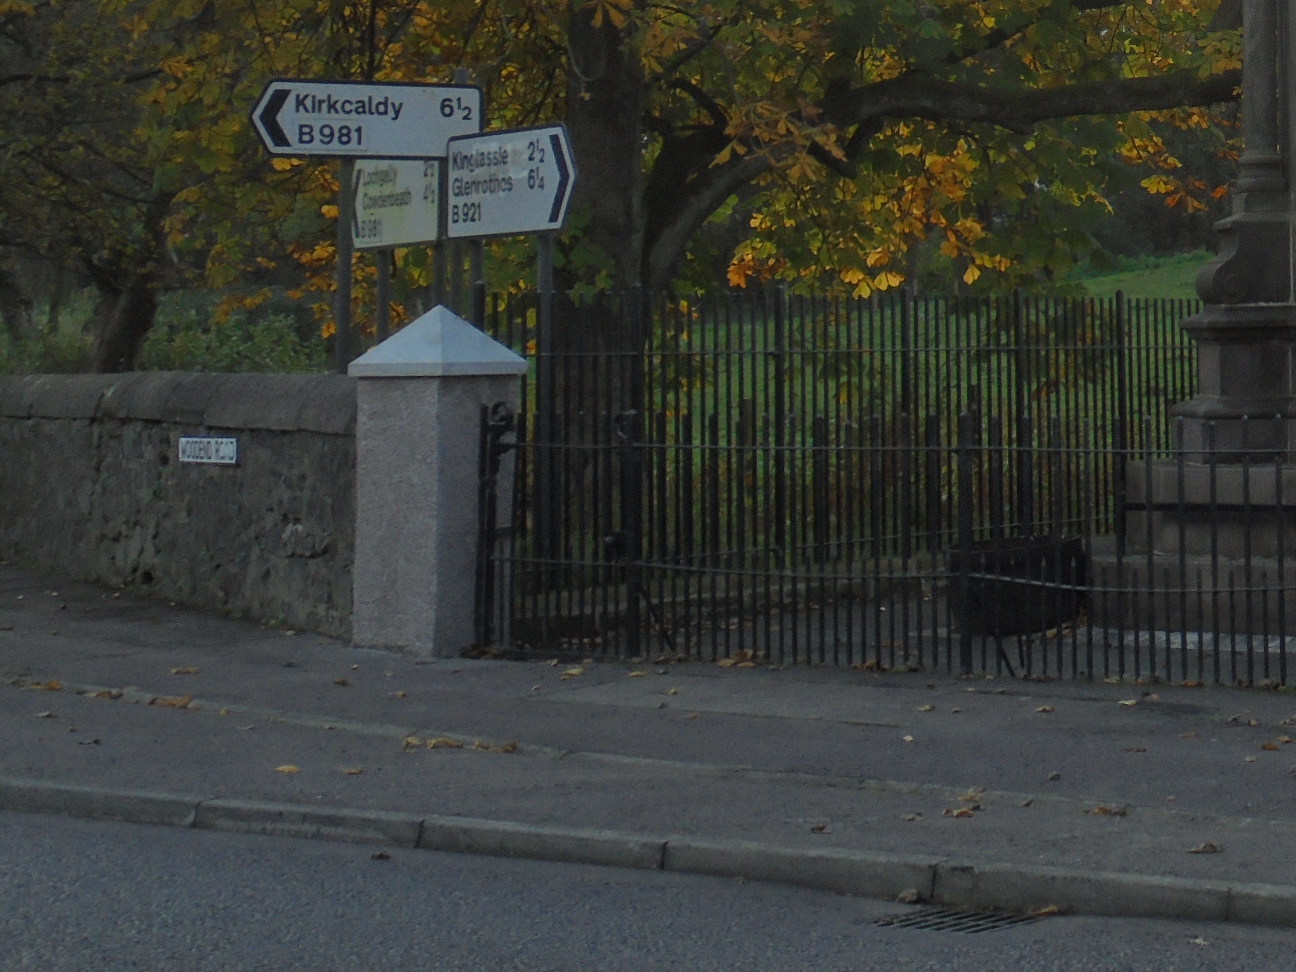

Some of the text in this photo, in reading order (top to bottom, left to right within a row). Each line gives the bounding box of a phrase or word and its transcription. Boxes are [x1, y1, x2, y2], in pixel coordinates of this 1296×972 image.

[295, 93, 403, 121] Kirkcaldy
[452, 147, 509, 173] Kinglassie
[452, 173, 513, 197] Glenrothes
[362, 187, 412, 210] Cowdenbeath
[215, 440, 234, 461] ROAD
